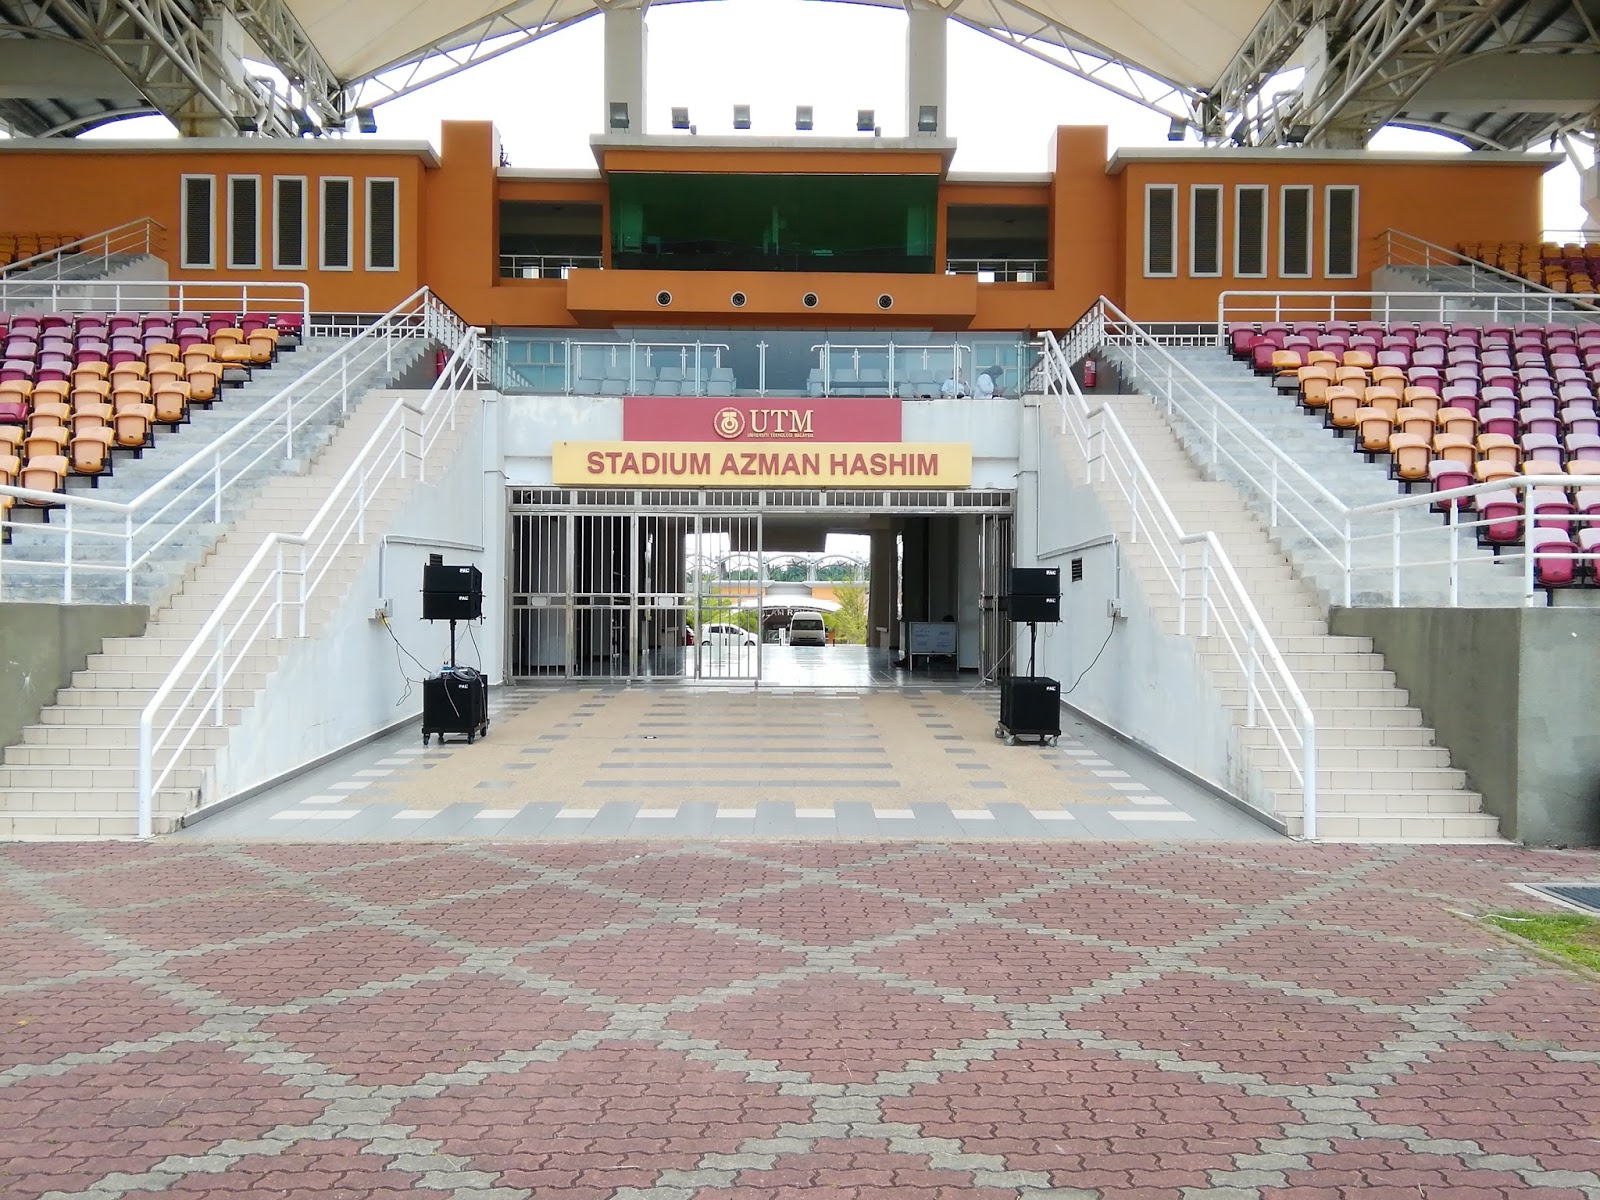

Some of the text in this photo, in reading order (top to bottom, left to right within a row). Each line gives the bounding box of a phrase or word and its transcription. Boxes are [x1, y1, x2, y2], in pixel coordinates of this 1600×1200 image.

[749, 409, 814, 433] UTM
[587, 451, 939, 476] STADIUM AZMAN HASHIM
